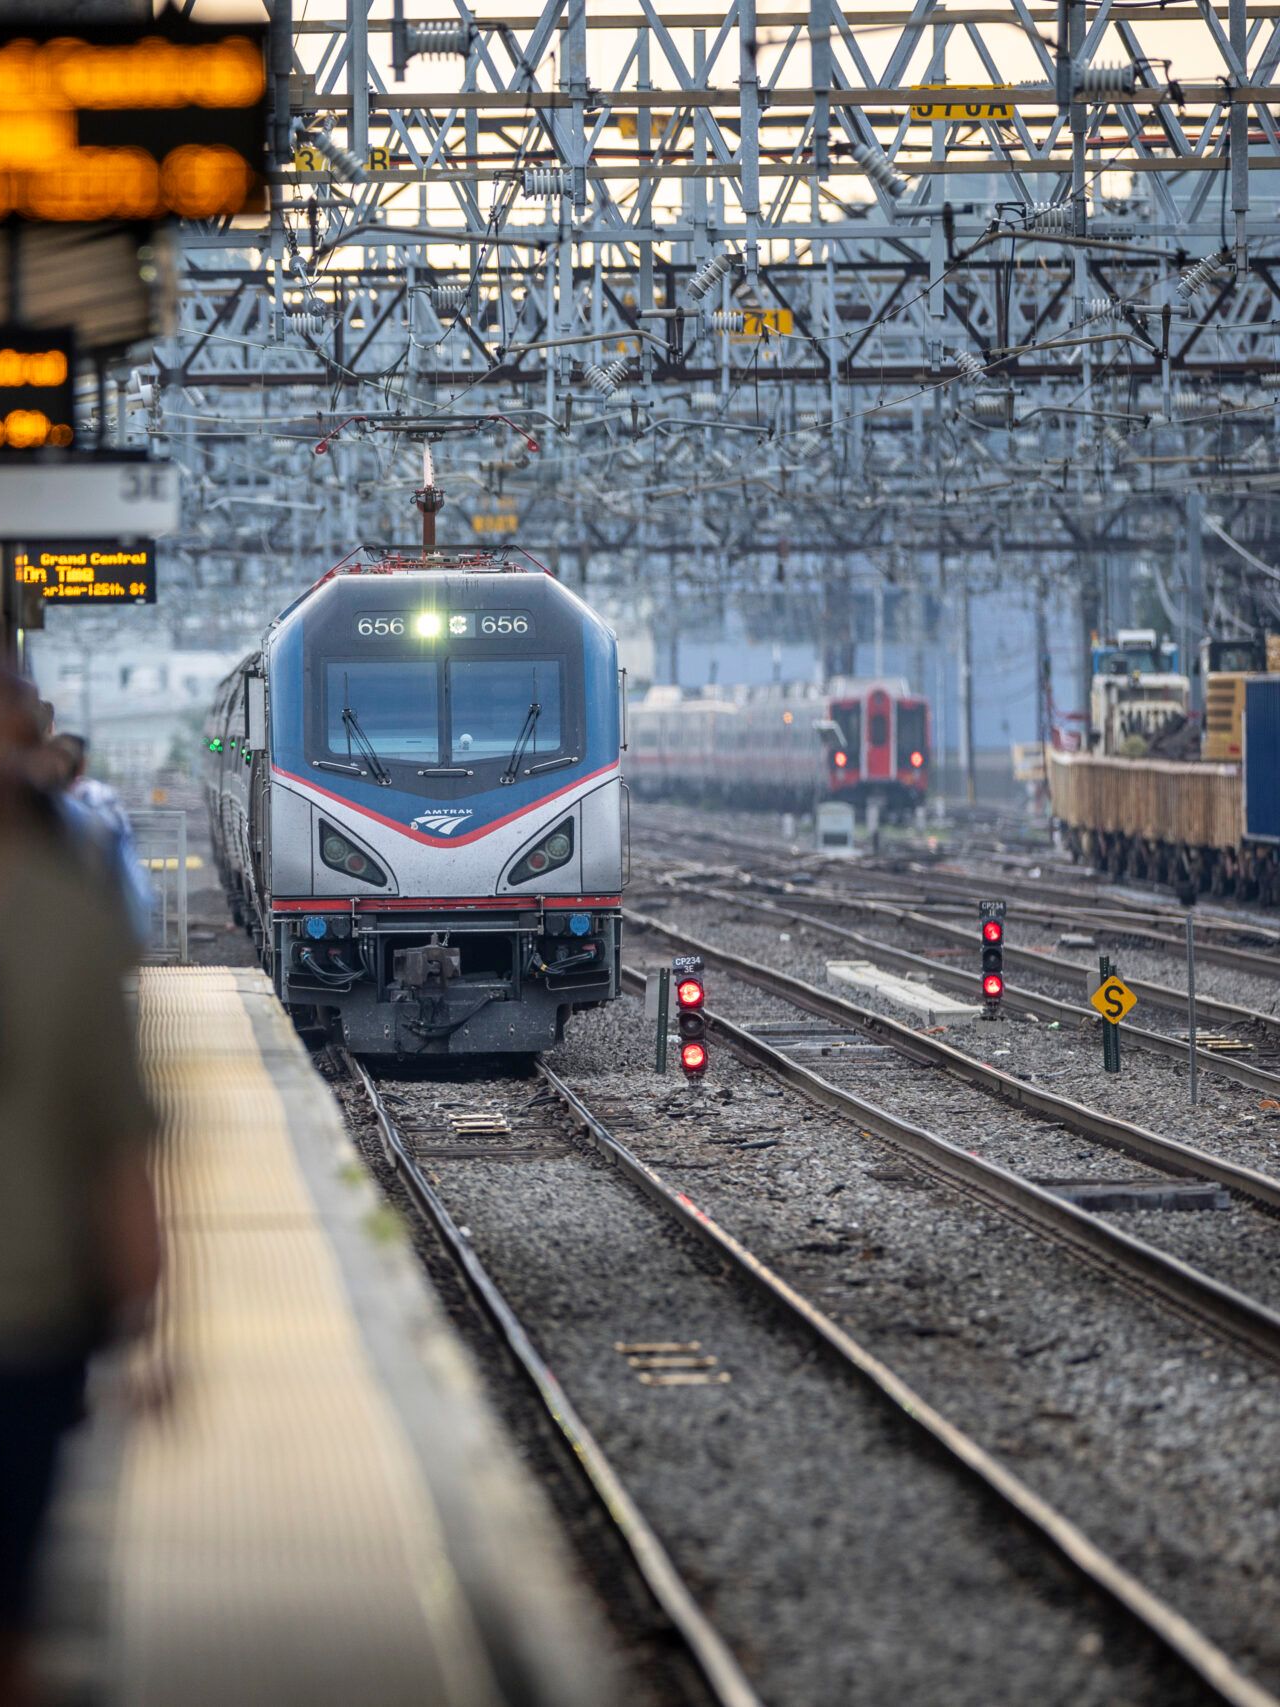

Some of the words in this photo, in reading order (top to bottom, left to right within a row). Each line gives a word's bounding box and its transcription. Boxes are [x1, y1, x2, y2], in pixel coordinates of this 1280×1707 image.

[40, 553, 87, 566] Grand
[90, 552, 147, 565] Central
[55, 567, 95, 583] Time
[43, 583, 125, 597] arlem-125th
[129, 581, 147, 596] St
[358, 617, 405, 636] 656
[481, 615, 528, 634] 656
[981, 901, 1004, 911] CP234
[675, 956, 701, 966] CP234
[684, 964, 695, 973] 3E
[1104, 985, 1124, 1018] S
